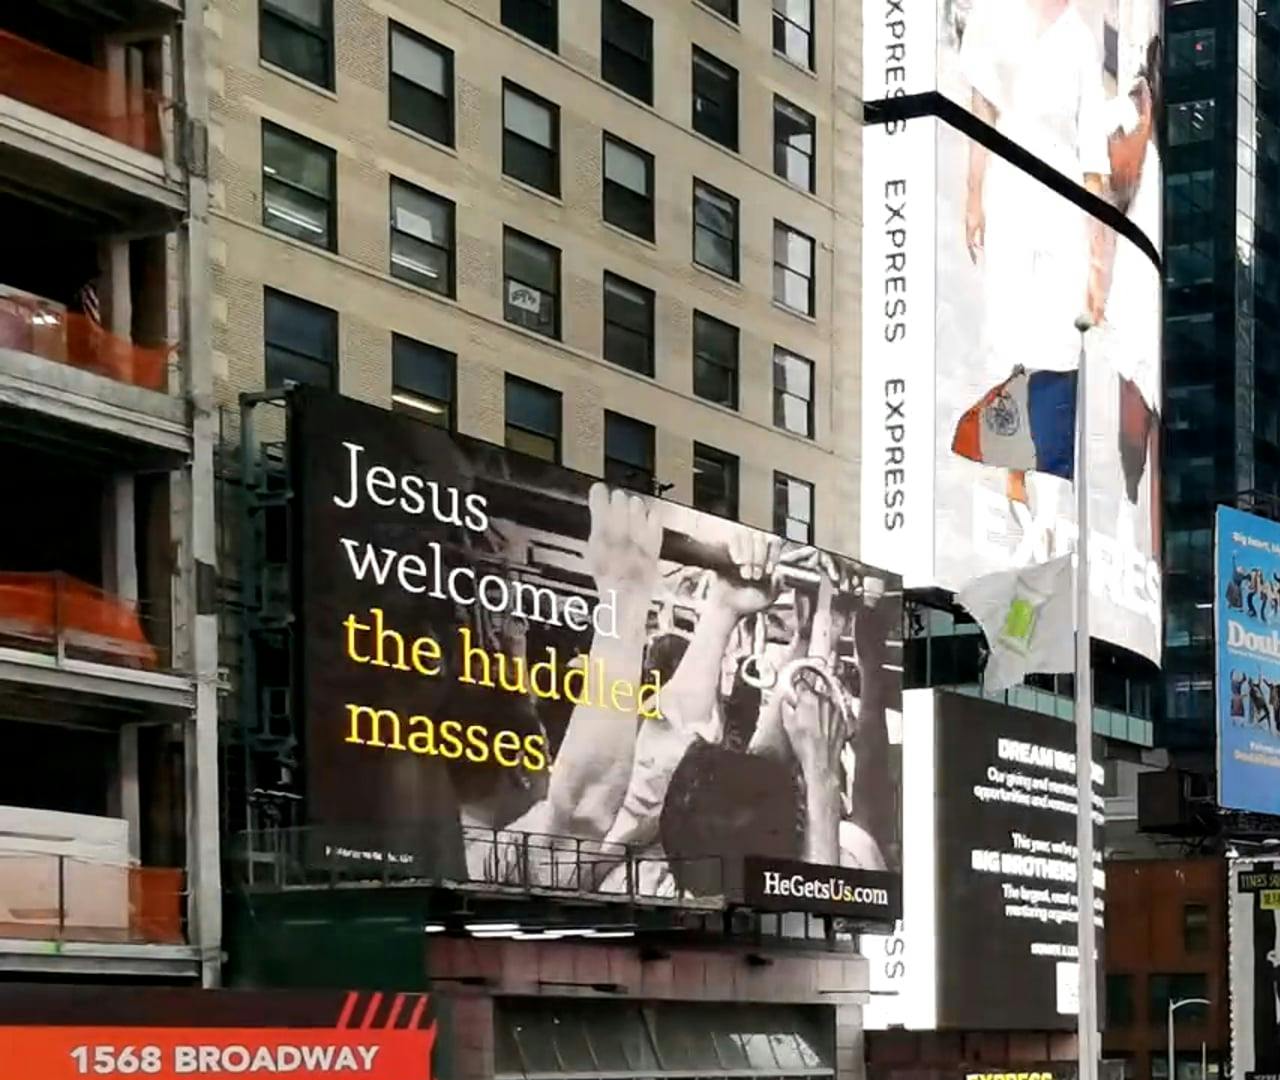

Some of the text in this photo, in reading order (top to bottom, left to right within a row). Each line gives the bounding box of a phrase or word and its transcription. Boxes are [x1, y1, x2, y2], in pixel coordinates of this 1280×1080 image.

[884, 179, 907, 343] EXPRESS
[334, 442, 490, 532] Jesus
[884, 379, 906, 531] EXPRESS
[341, 532, 621, 640] welcomed
[343, 608, 665, 721] the huddled
[345, 701, 556, 774] masses.
[998, 737, 1053, 770] DREAM
[764, 870, 889, 910] HeGetsUs.com
[972, 849, 1077, 882] BIG BROTHERS
[70, 1042, 380, 1075] 1568 BROADWAY
